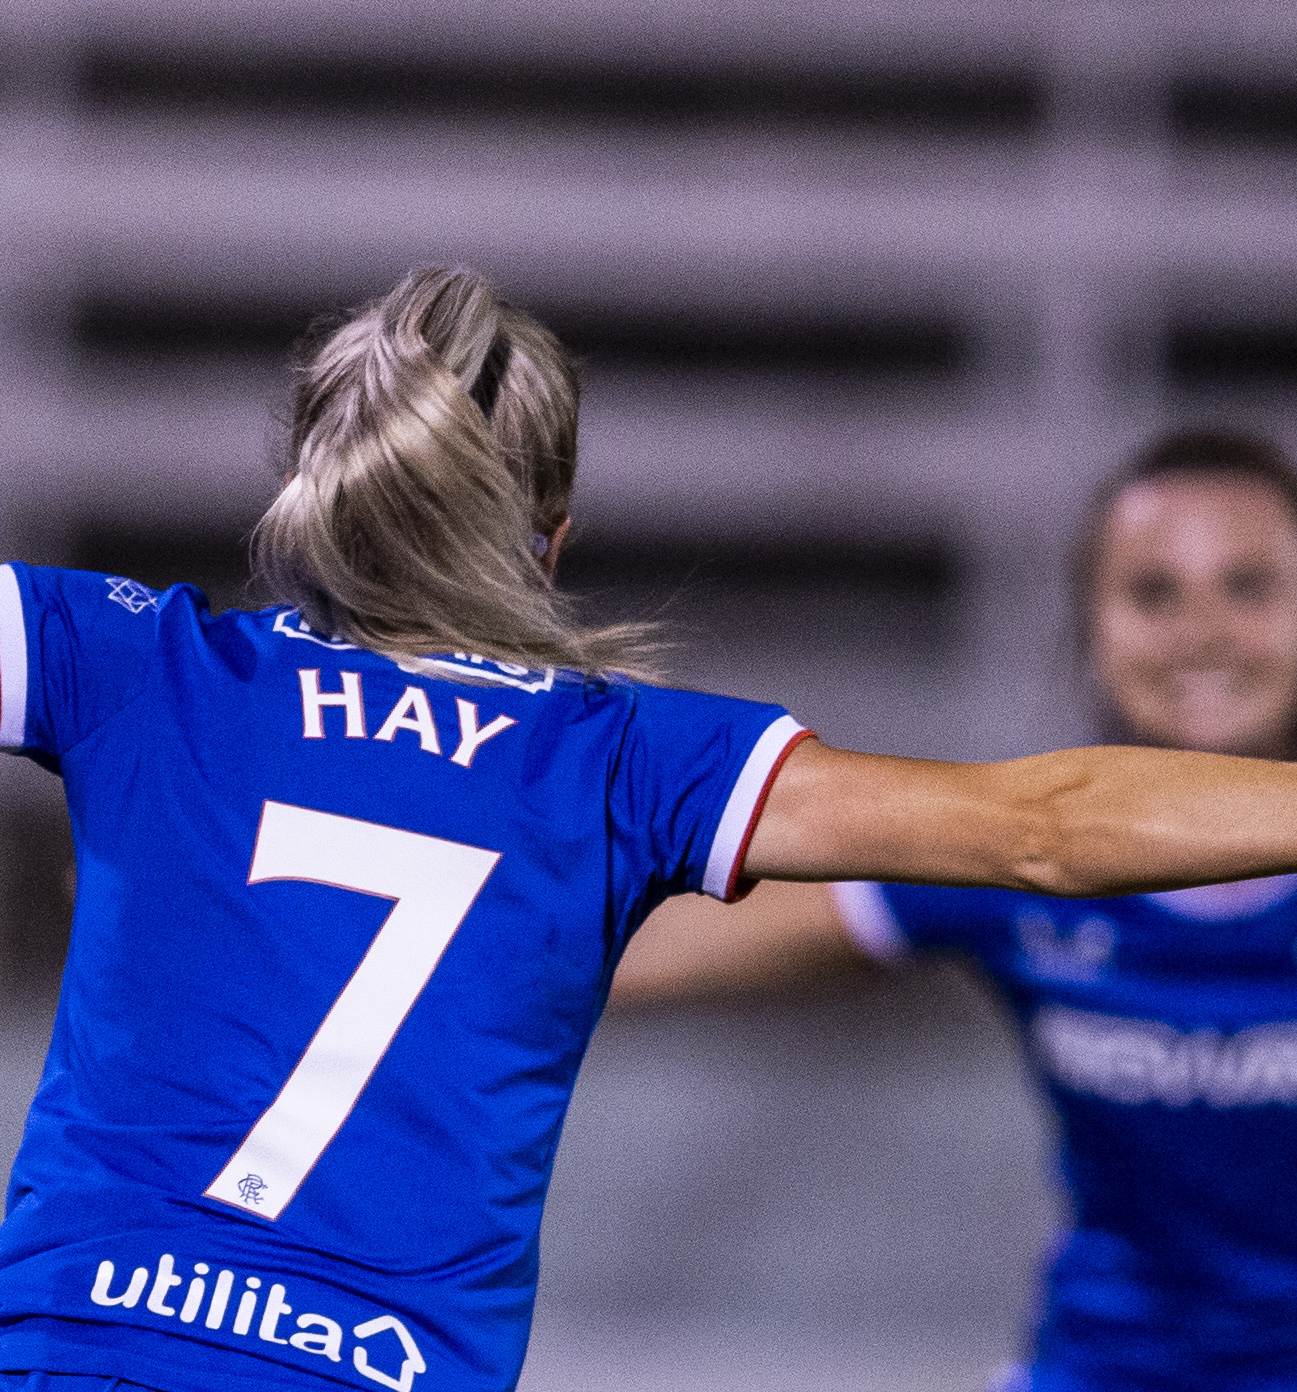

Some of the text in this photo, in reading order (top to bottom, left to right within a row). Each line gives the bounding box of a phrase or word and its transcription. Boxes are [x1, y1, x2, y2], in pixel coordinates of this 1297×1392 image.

[297, 667, 520, 769] HAY
[200, 798, 504, 1222] 7
[90, 1253, 343, 1363] utilita
